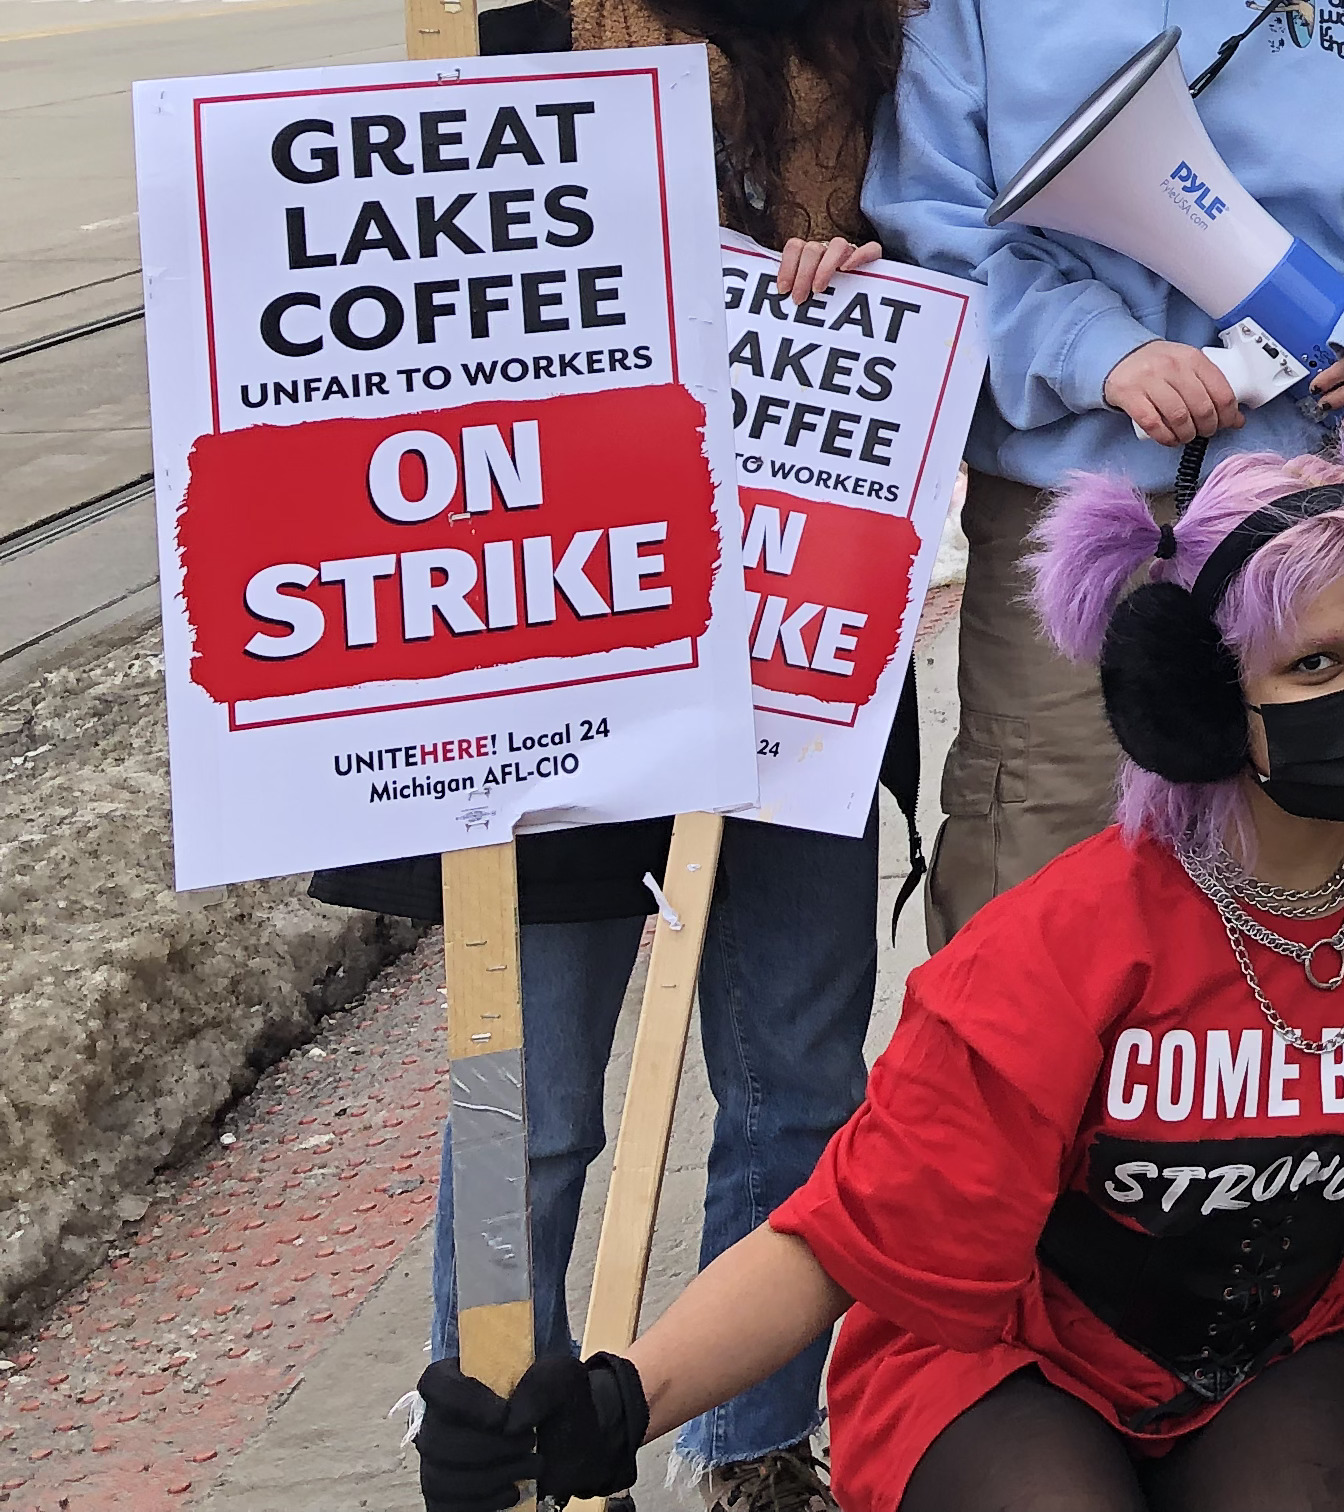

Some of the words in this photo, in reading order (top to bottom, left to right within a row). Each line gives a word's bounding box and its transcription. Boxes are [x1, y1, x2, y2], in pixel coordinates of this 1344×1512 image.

[272, 101, 595, 184] GREAT
[285, 185, 594, 270] LAKES
[1160, 178, 1209, 231] PyleUSAcom
[260, 265, 626, 357] COFFEE
[241, 372, 389, 408] UNFAIR
[397, 366, 451, 392] TO
[461, 346, 652, 386] WORKERS
[729, 330, 896, 402] AKES
[370, 420, 543, 521] ON
[770, 459, 900, 502] WORKERS
[742, 504, 807, 576] N
[245, 522, 672, 657] STRIKE
[335, 734, 496, 776] UNITEHERE!
[508, 723, 571, 752] Local
[580, 717, 610, 741] 24
[370, 776, 474, 803] Michigan
[483, 753, 579, 786] AFL-CIO
[757, 739, 781, 758] 24
[1107, 1025, 1300, 1122] COME
